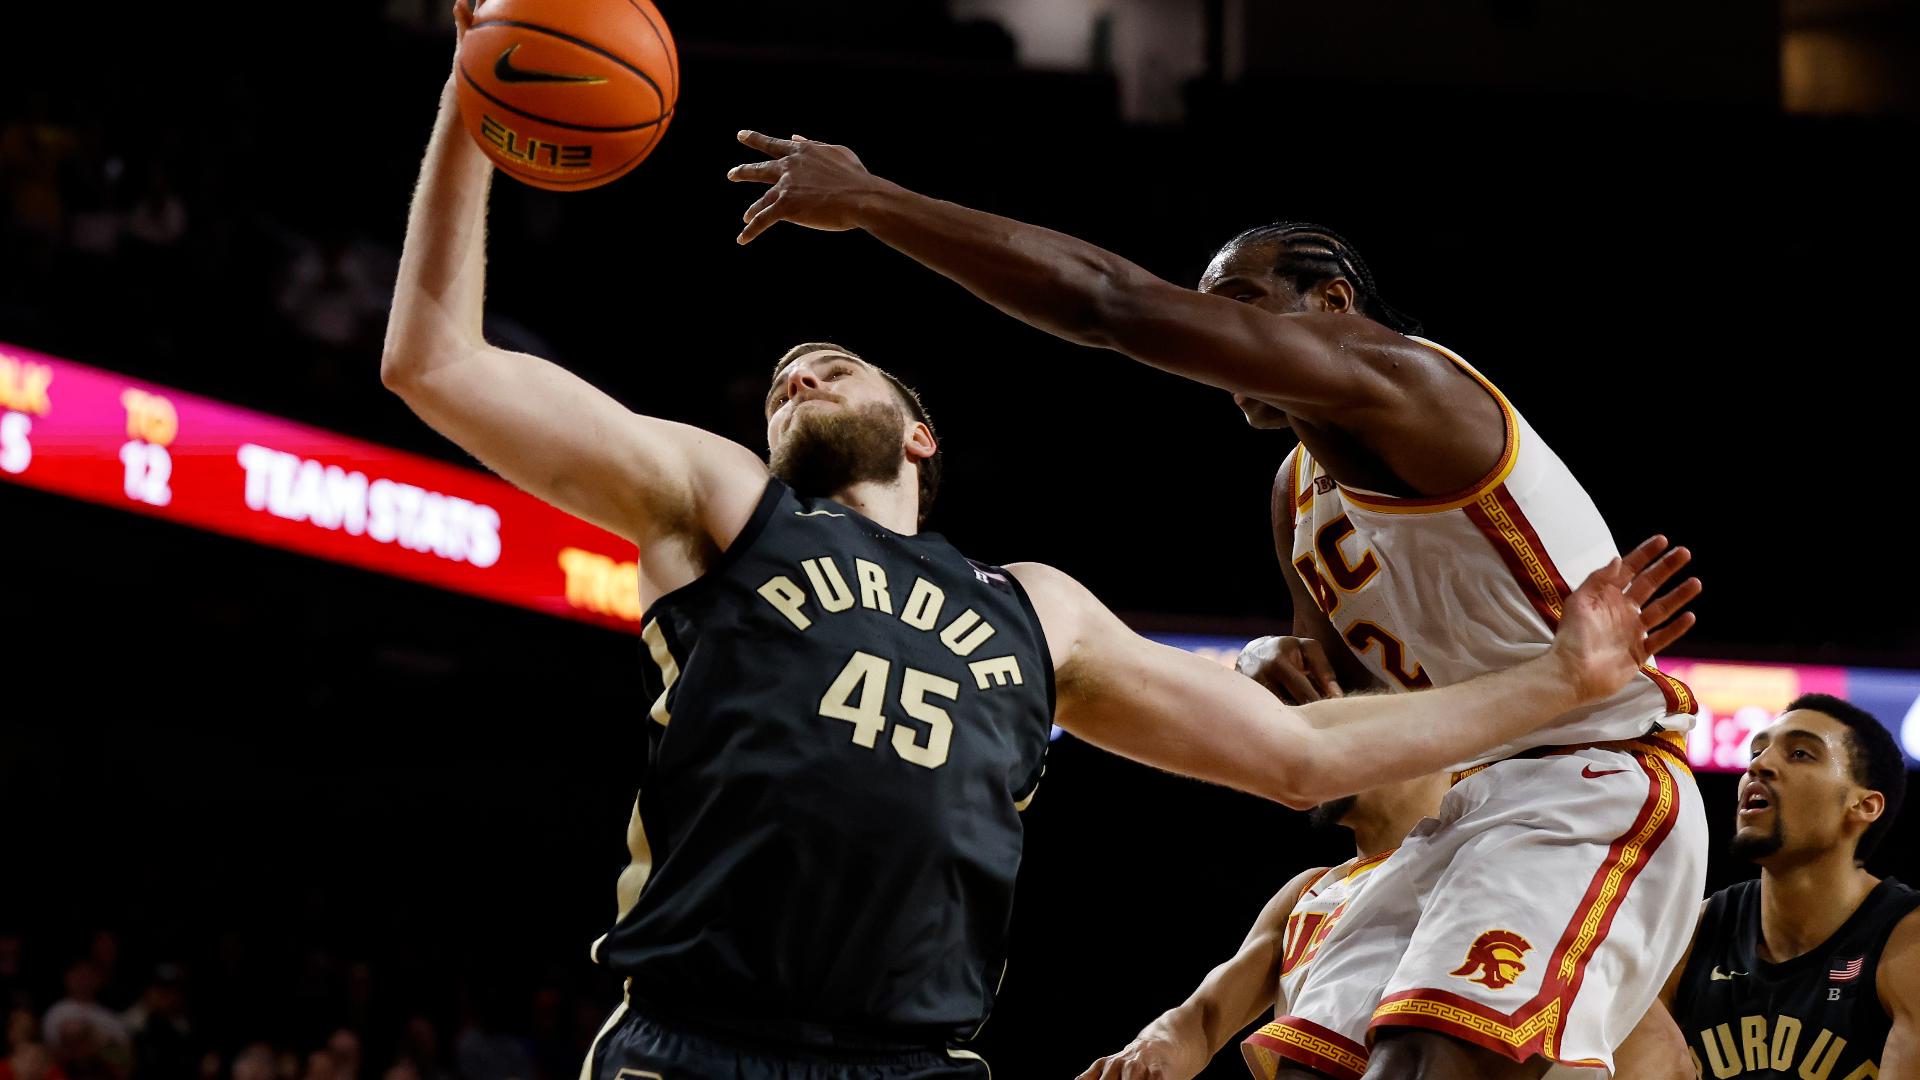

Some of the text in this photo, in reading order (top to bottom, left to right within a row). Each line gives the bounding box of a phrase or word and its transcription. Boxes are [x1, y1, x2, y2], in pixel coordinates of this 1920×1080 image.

[481, 113, 593, 168] ELITE
[0, 353, 179, 447] LK TO
[119, 440, 172, 506] 12
[237, 443, 501, 568] TEAM STATS
[756, 556, 1024, 691] PURDUE
[1343, 619, 1436, 691] 2
[818, 650, 960, 770] 45
